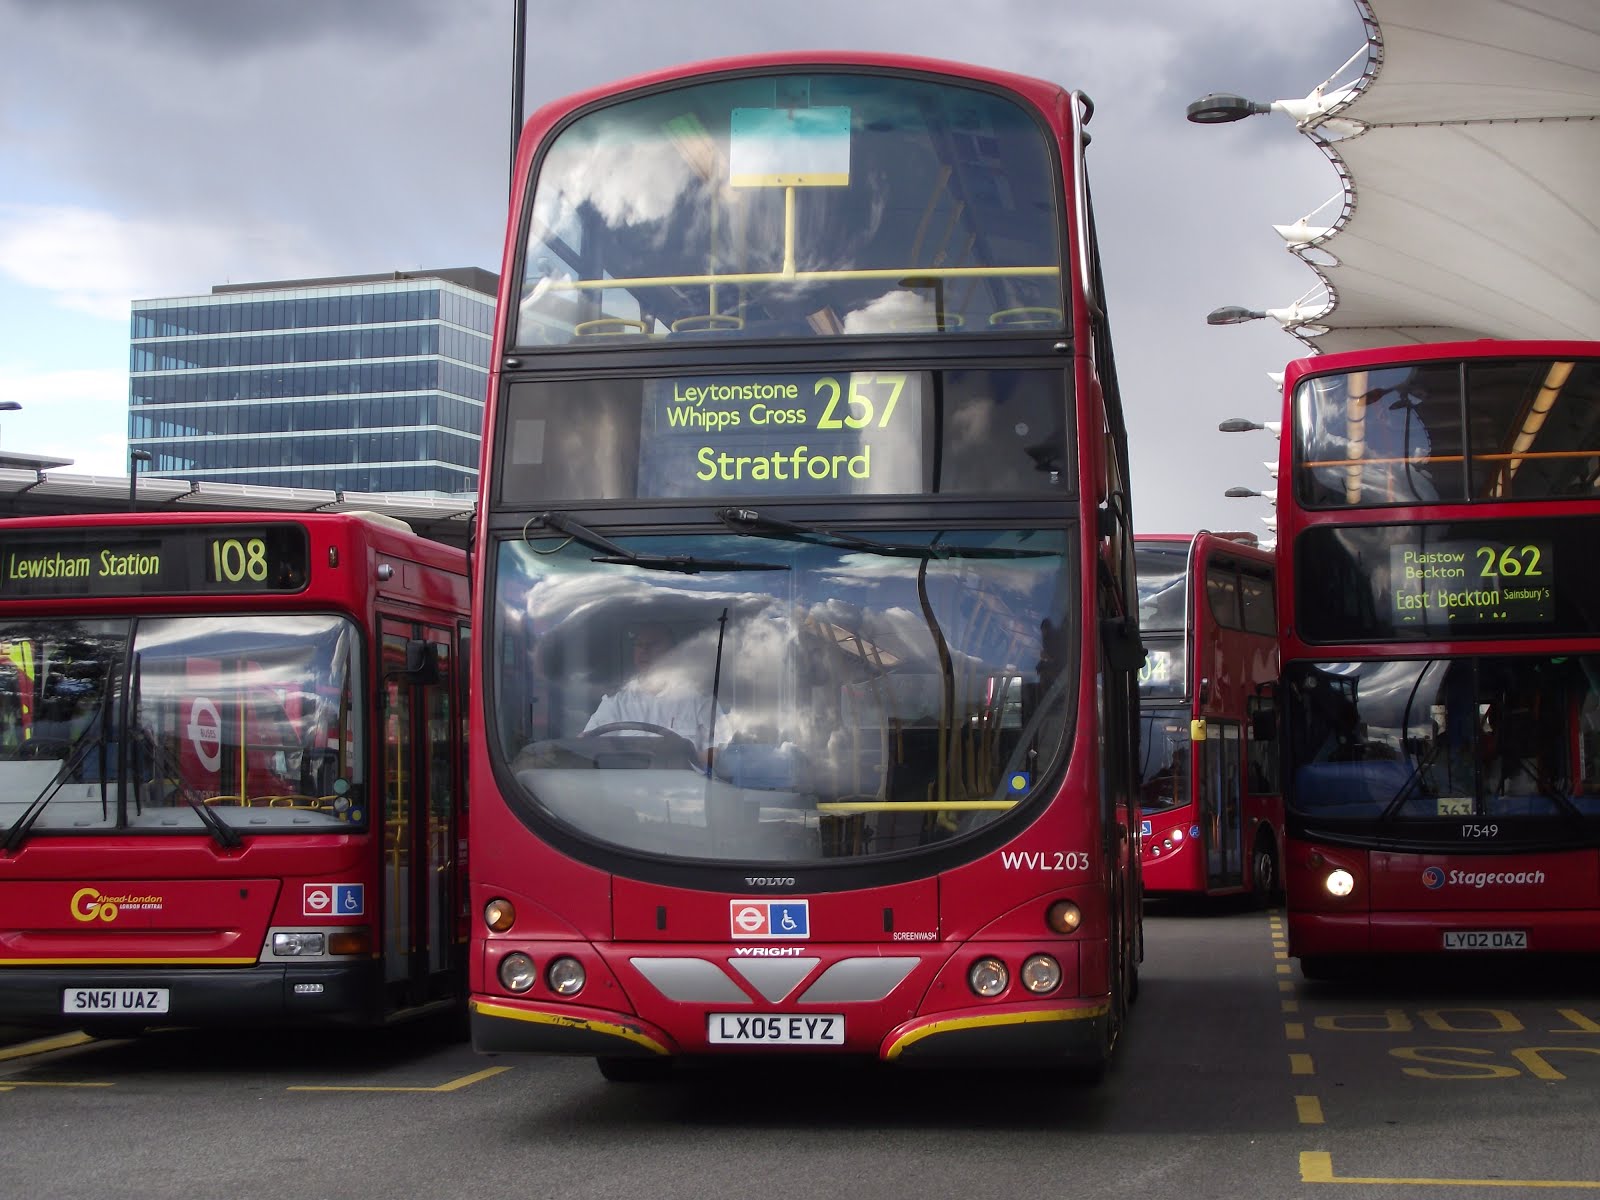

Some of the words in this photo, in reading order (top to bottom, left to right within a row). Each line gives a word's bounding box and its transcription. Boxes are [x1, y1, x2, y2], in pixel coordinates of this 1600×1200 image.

[674, 382, 798, 407] Leytonstone
[814, 376, 907, 429] 257
[667, 405, 741, 432] Whipps
[749, 403, 807, 425] Cross
[696, 445, 871, 481] Stratford
[9, 552, 91, 579] Lewisham
[98, 549, 160, 576] Station
[213, 538, 268, 582] 108
[1403, 551, 1465, 564] Plaistow
[1476, 545, 1543, 577] 262
[1405, 566, 1465, 579] Beckton
[1396, 589, 1431, 610] East
[1438, 588, 1500, 608] Beckton
[1503, 587, 1550, 602] Sainsbury's
[1137, 655, 1167, 681] 04
[1462, 824, 1499, 838] 17549
[1001, 851, 1090, 870] WVL203
[745, 877, 796, 886] VOLVO
[1449, 870, 1545, 888] Stagecoach
[71, 888, 118, 922] Go
[893, 932, 937, 940] SCREENWASH
[1445, 933, 1489, 948] LY02
[1492, 933, 1526, 948] OAZ
[734, 947, 805, 956] WRIGHT
[76, 991, 117, 1009] SN51
[122, 991, 158, 1009] UAZ
[720, 1017, 781, 1040] LX05
[788, 1017, 834, 1040] EYZ
[1314, 1008, 1600, 1032] TOP
[1388, 1046, 1600, 1080] US
